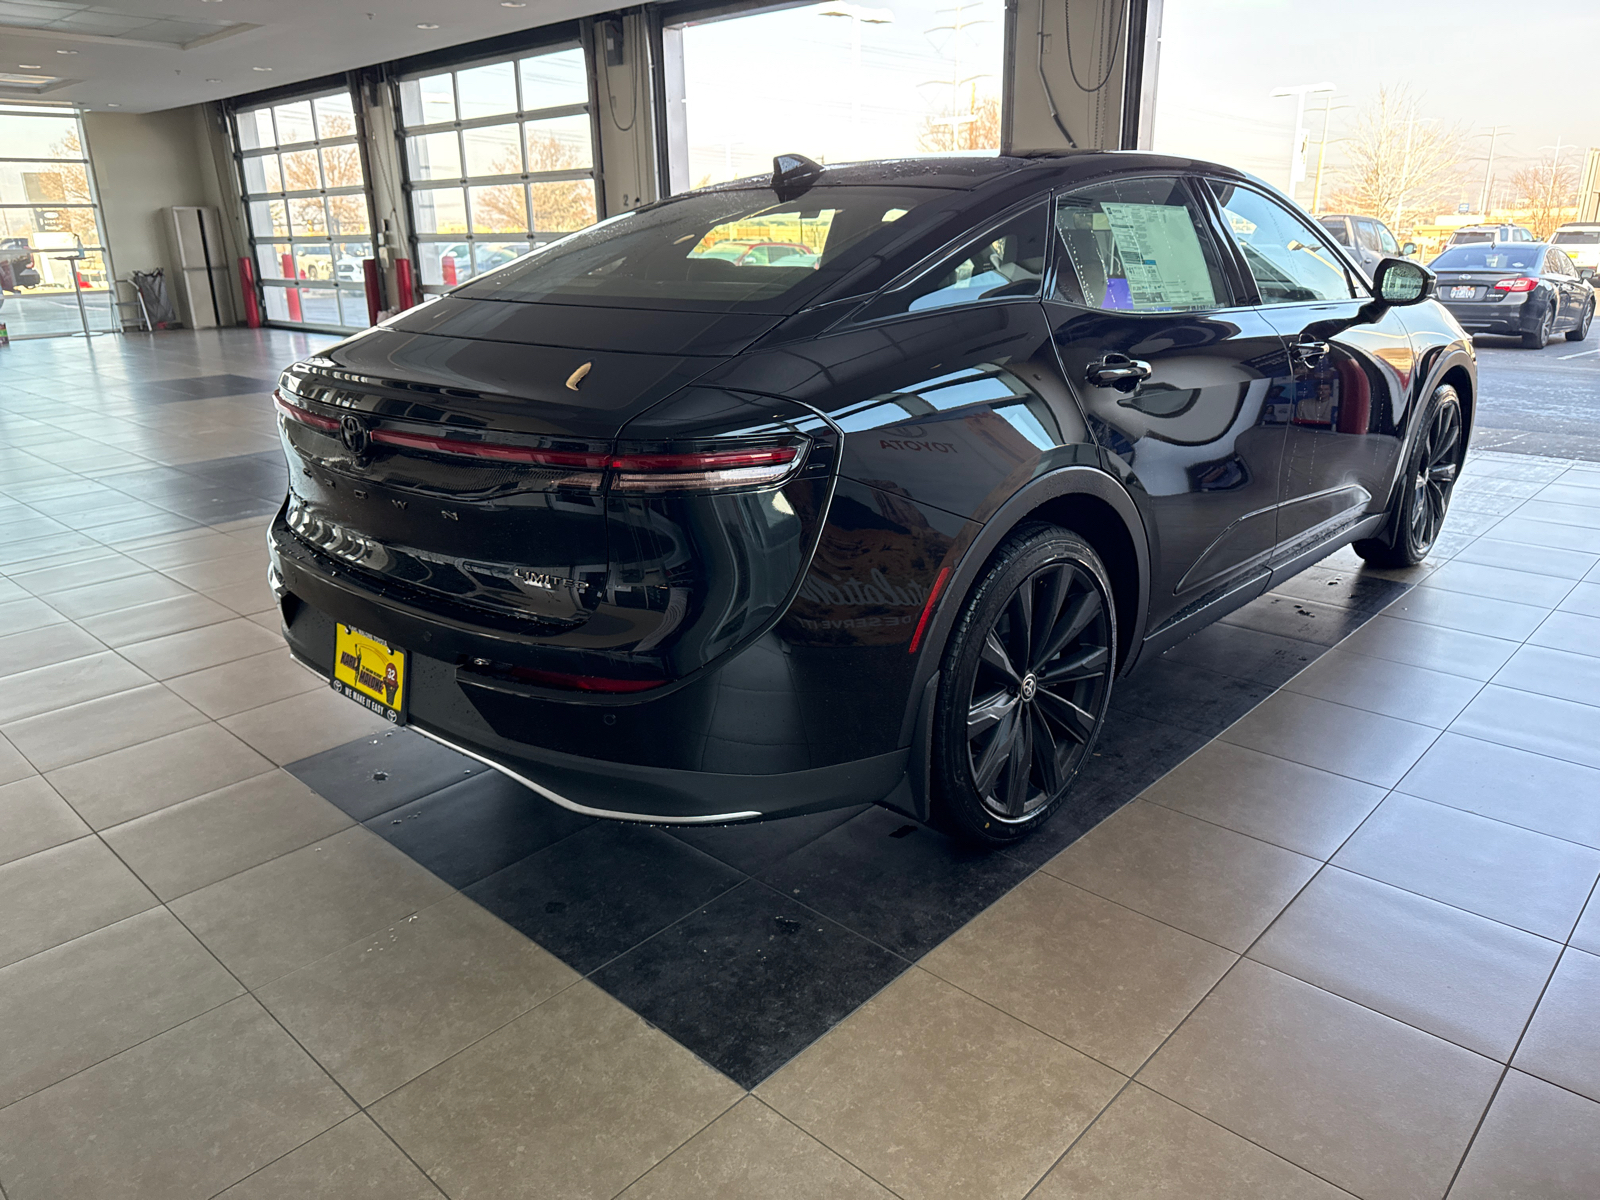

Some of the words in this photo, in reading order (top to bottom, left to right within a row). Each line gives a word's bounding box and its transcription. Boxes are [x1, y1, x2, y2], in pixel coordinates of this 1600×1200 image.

[623, 194, 629, 206] 2
[515, 568, 589, 588] LIMITED
[387, 668, 396, 681] 32
[345, 686, 352, 698] WE
[352, 690, 365, 706] MAKE
[365, 698, 371, 708] IT
[371, 701, 384, 715] EASY
